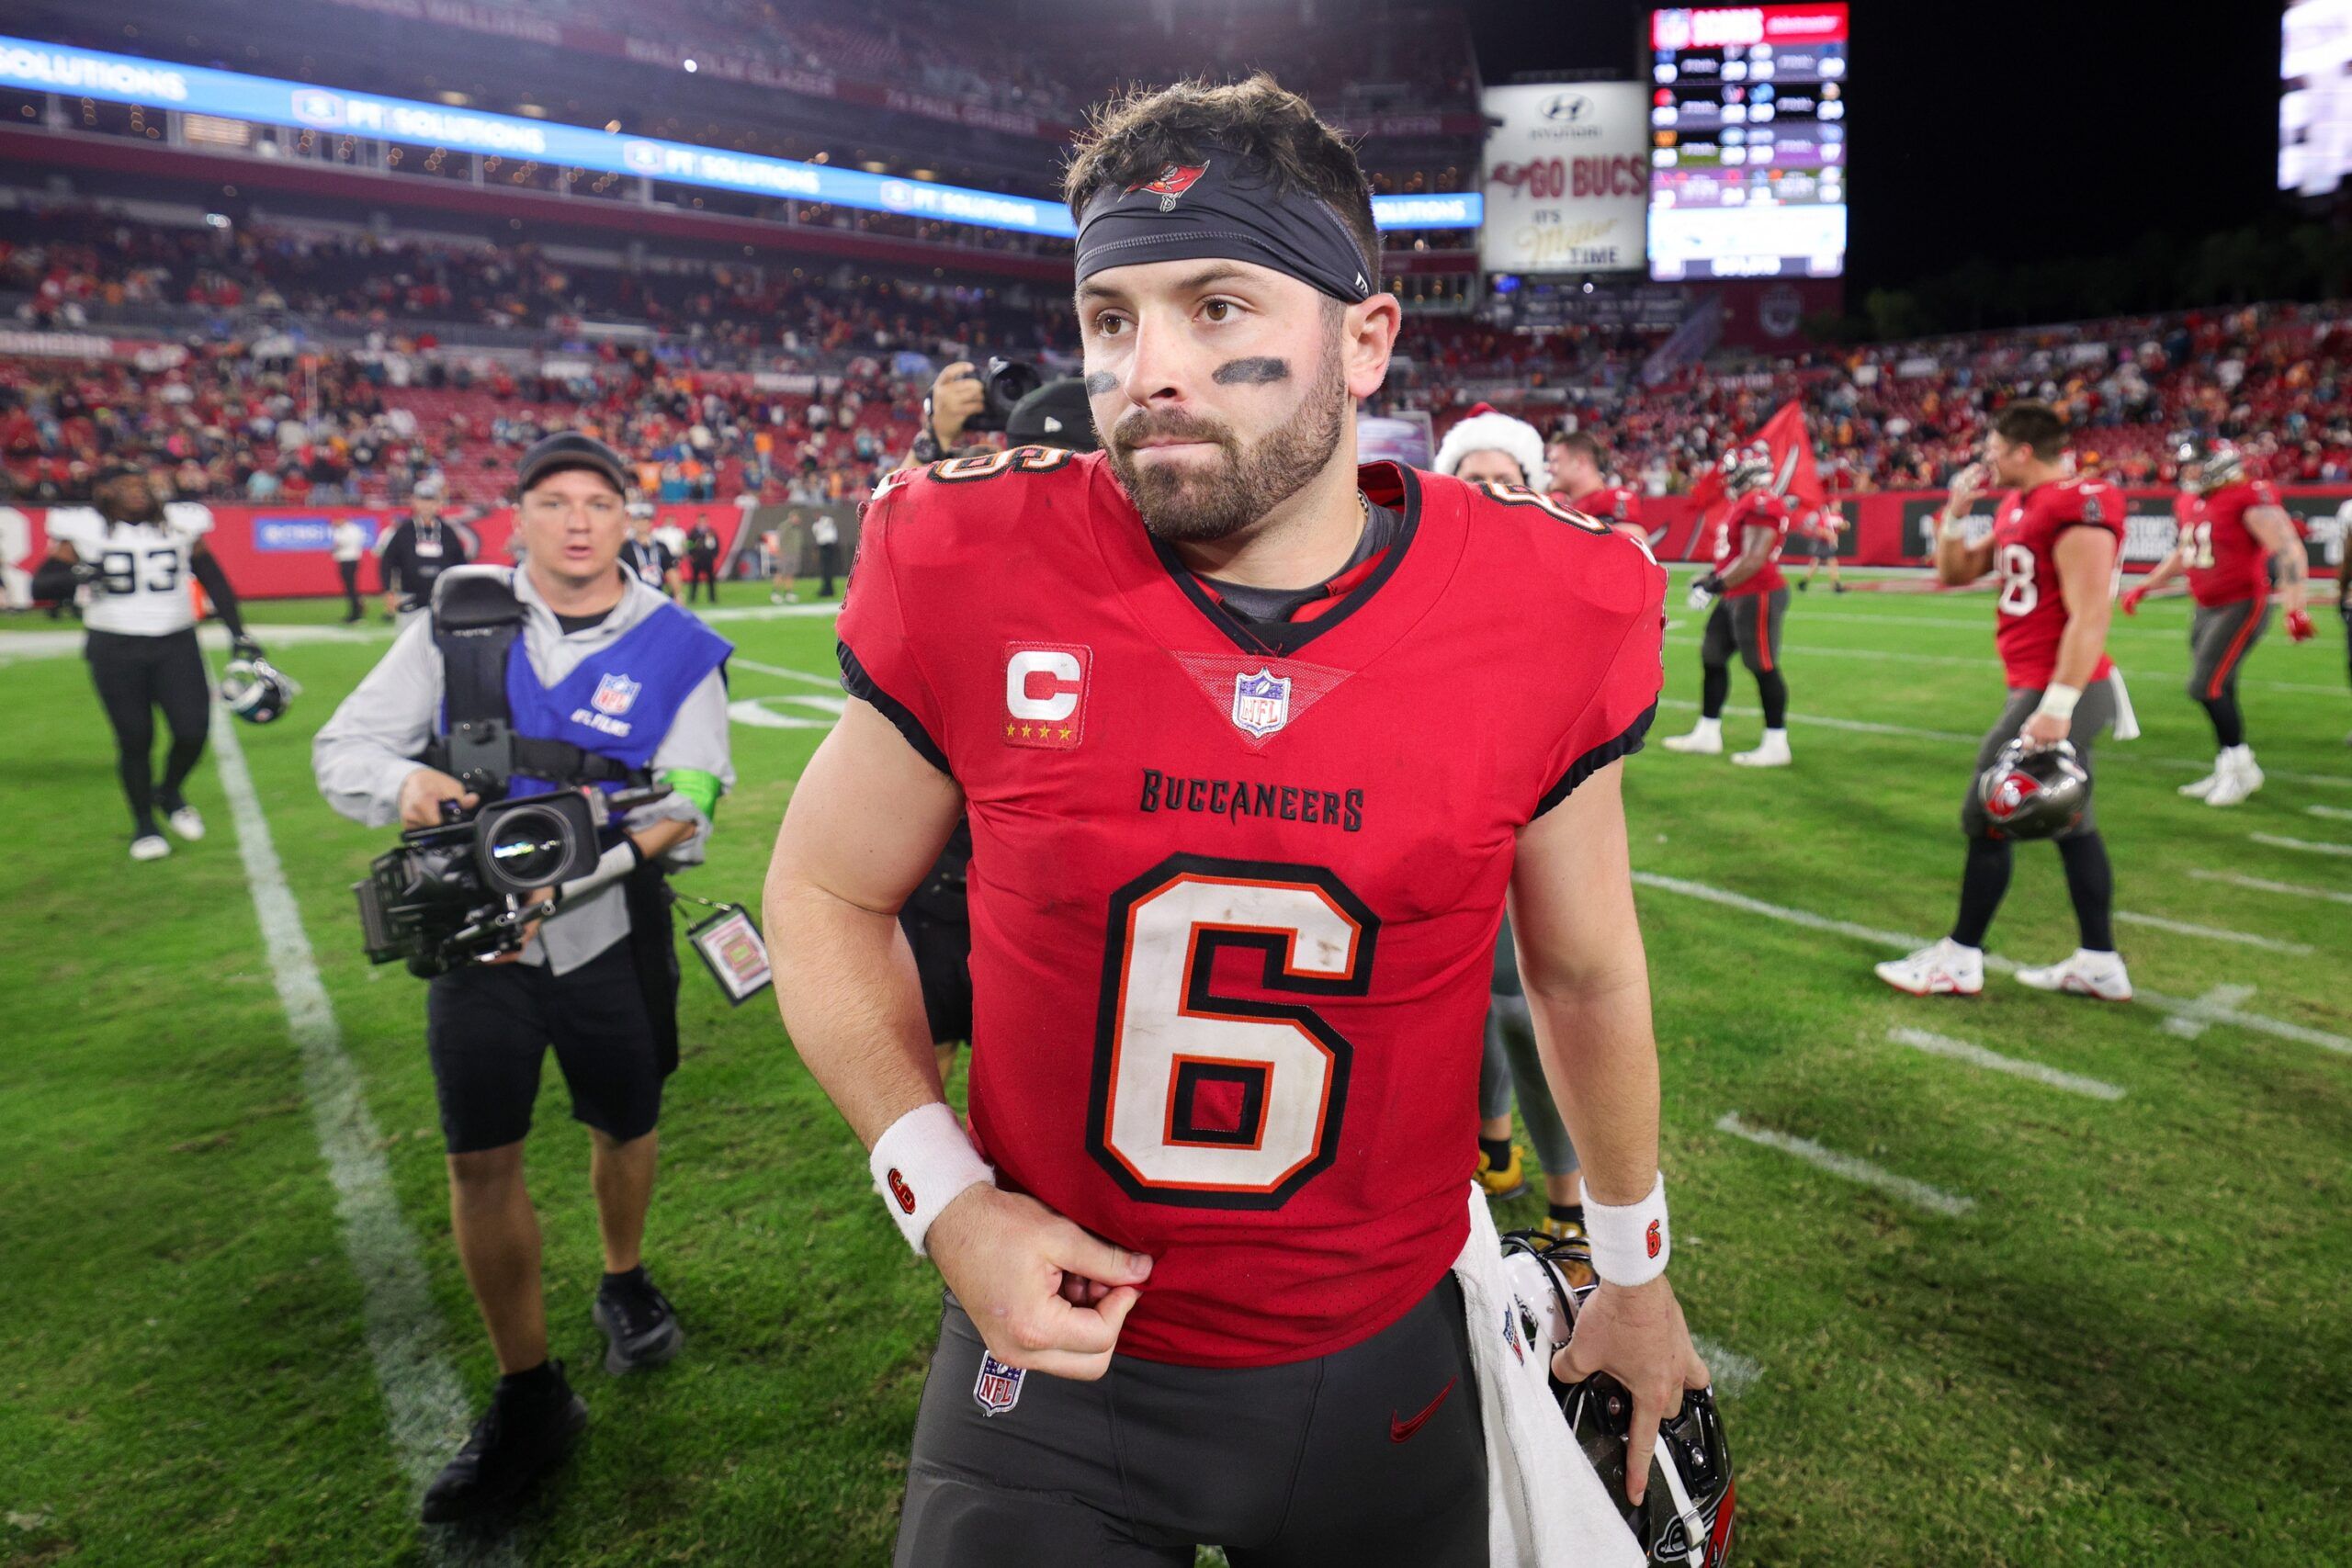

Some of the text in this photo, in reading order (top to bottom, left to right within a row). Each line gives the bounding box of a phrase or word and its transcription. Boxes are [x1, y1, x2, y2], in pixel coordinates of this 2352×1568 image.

[1572, 154, 1646, 197] BUCS
[102, 549, 177, 594] 93
[1994, 544, 2038, 616] 8
[1006, 650, 1080, 721] C
[1240, 696, 1279, 726] NFL
[1085, 851, 1382, 1212] 6
[887, 1168, 917, 1215] 6
[1646, 1219, 1661, 1258] 6
[980, 1375, 1012, 1404] NFL
